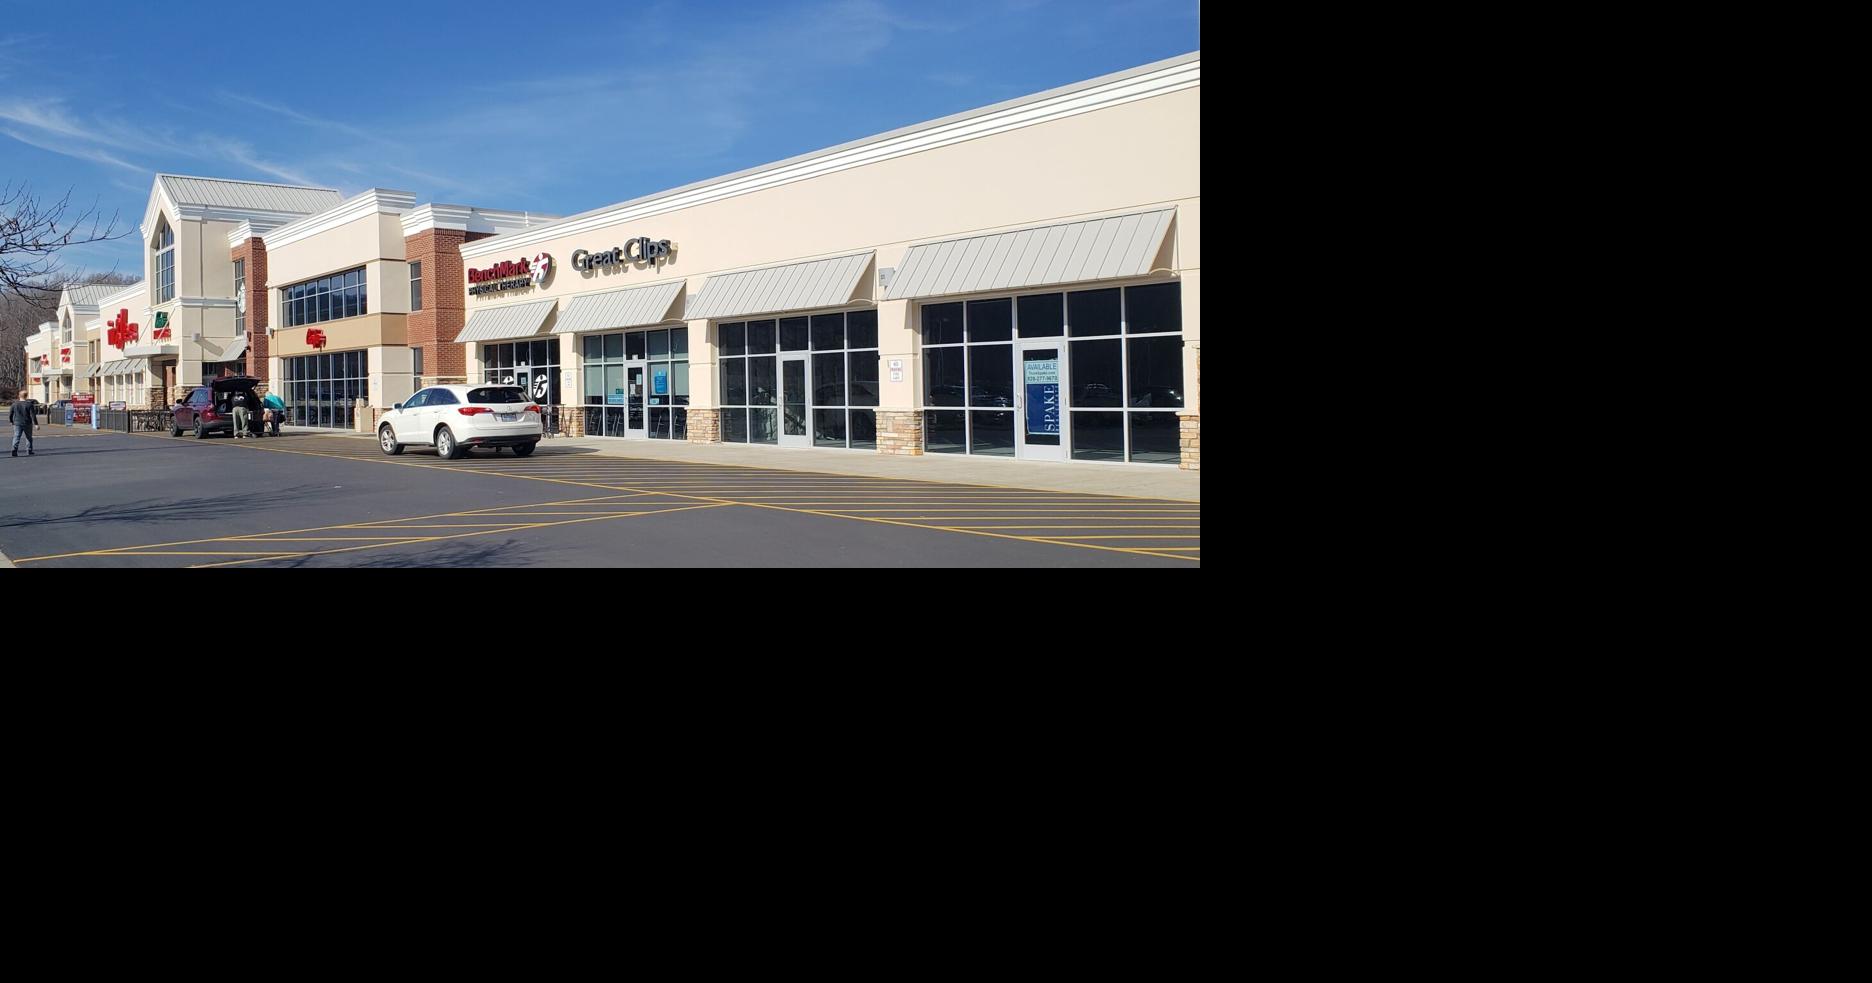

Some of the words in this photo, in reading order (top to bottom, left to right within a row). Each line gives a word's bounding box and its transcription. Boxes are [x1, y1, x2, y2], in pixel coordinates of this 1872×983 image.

[571, 248, 622, 271] Great
[624, 237, 672, 265] Clips
[468, 257, 530, 284] BenchMark
[469, 283, 499, 296] PHYSICAL
[500, 277, 532, 291] THERAPY
[1027, 362, 1057, 370] AVAILABLE
[1044, 384, 1055, 432] SPAKE
